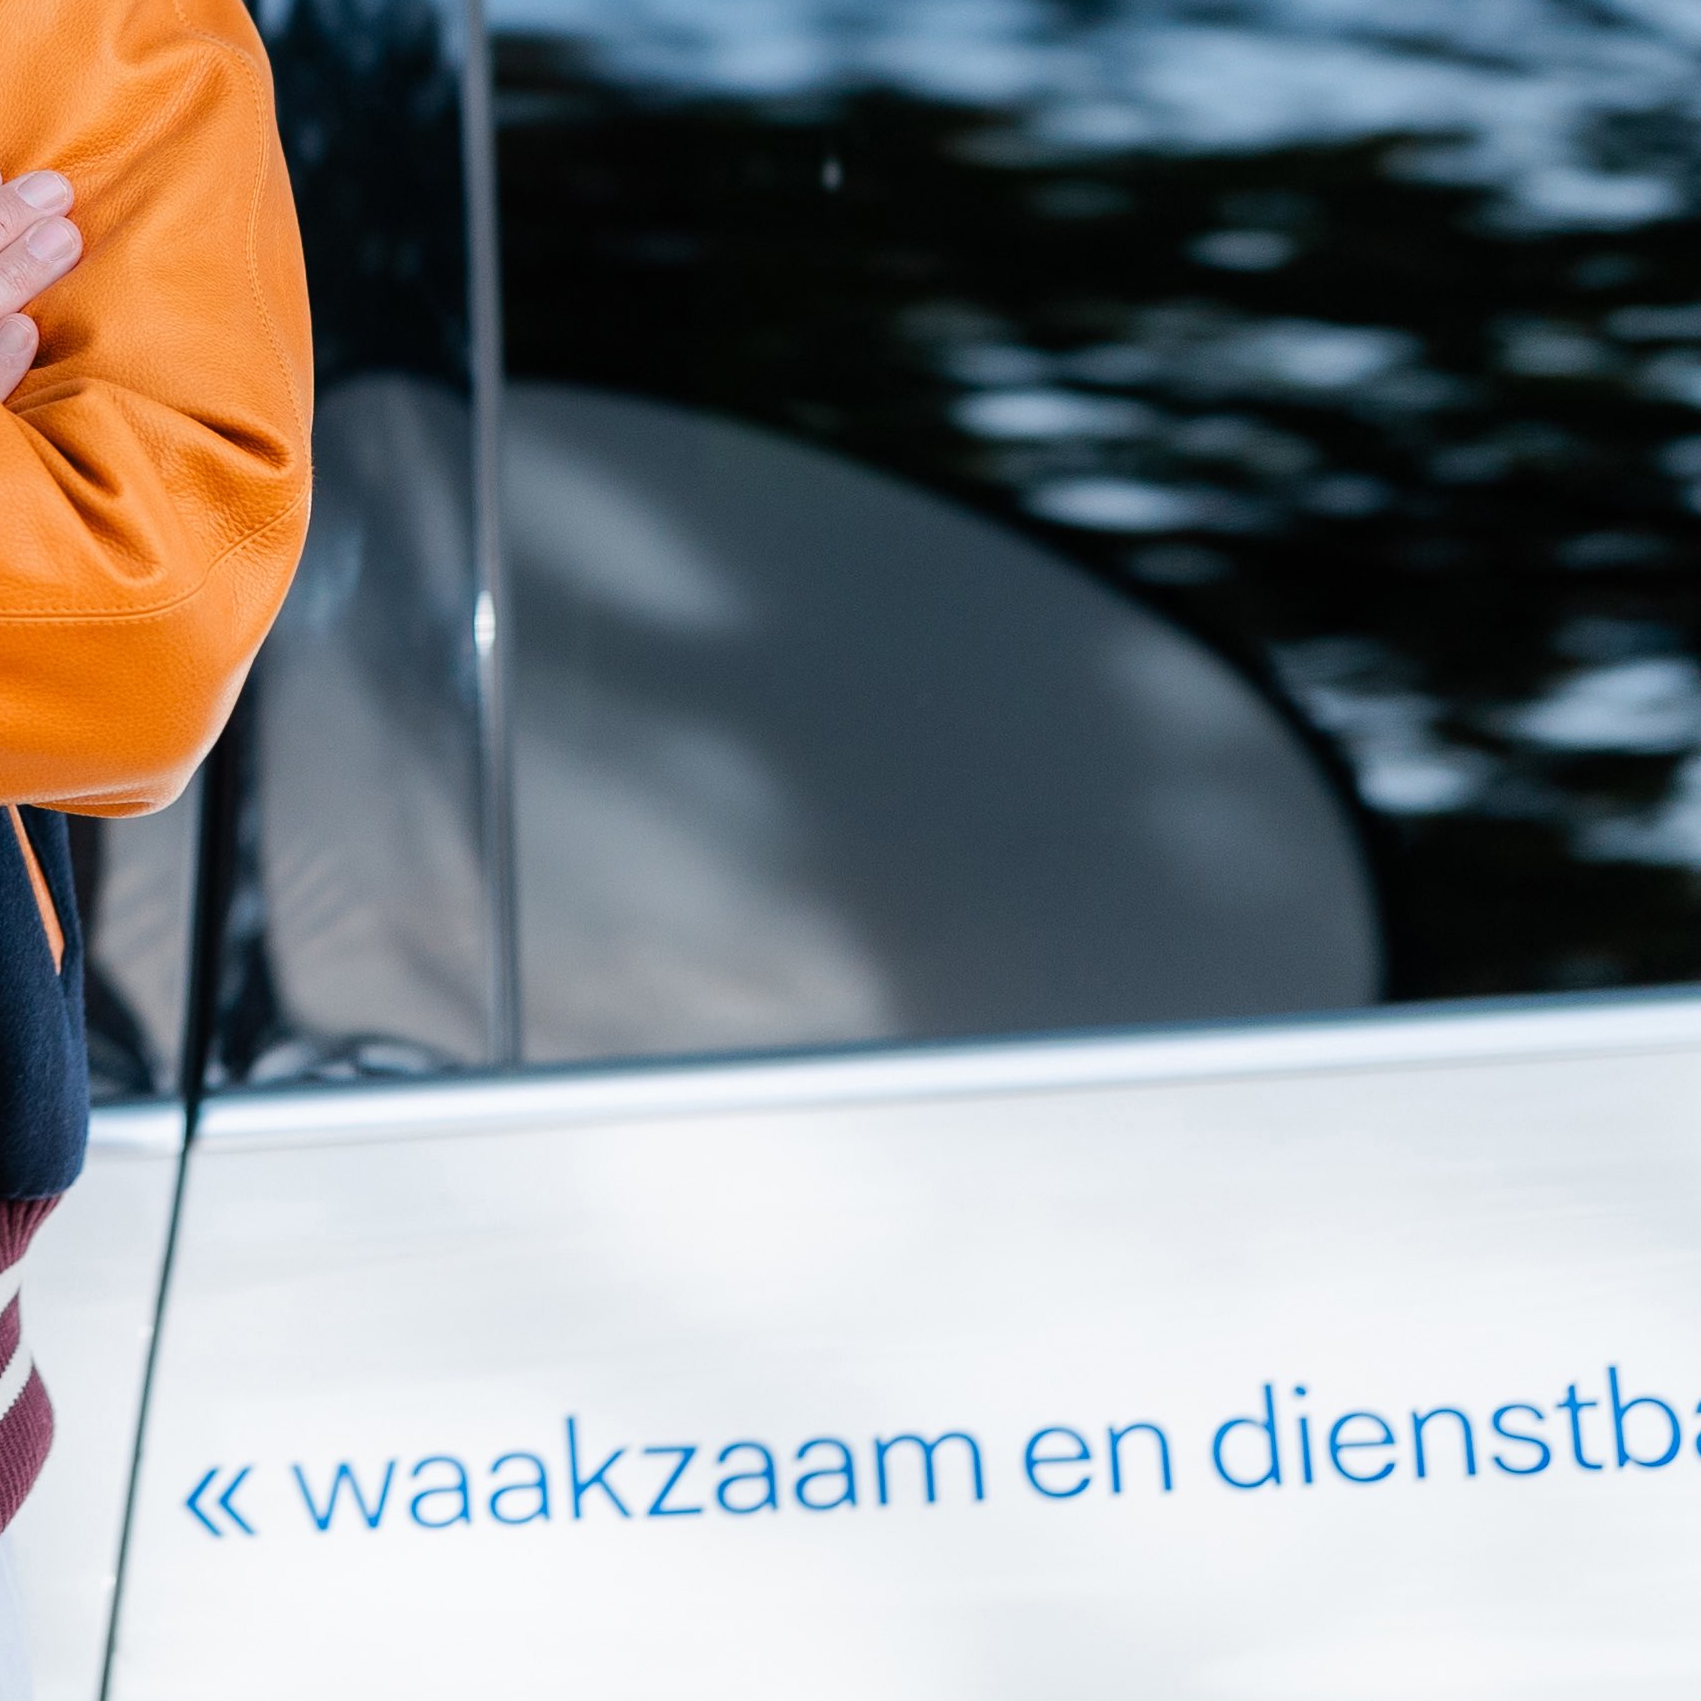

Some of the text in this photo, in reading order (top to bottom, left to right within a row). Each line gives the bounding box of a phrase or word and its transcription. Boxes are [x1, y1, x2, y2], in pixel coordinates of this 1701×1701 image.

[291, 1414, 987, 1534] waakzaam
[1021, 1420, 1175, 1500] en
[1209, 1363, 1701, 1492] dienstb
